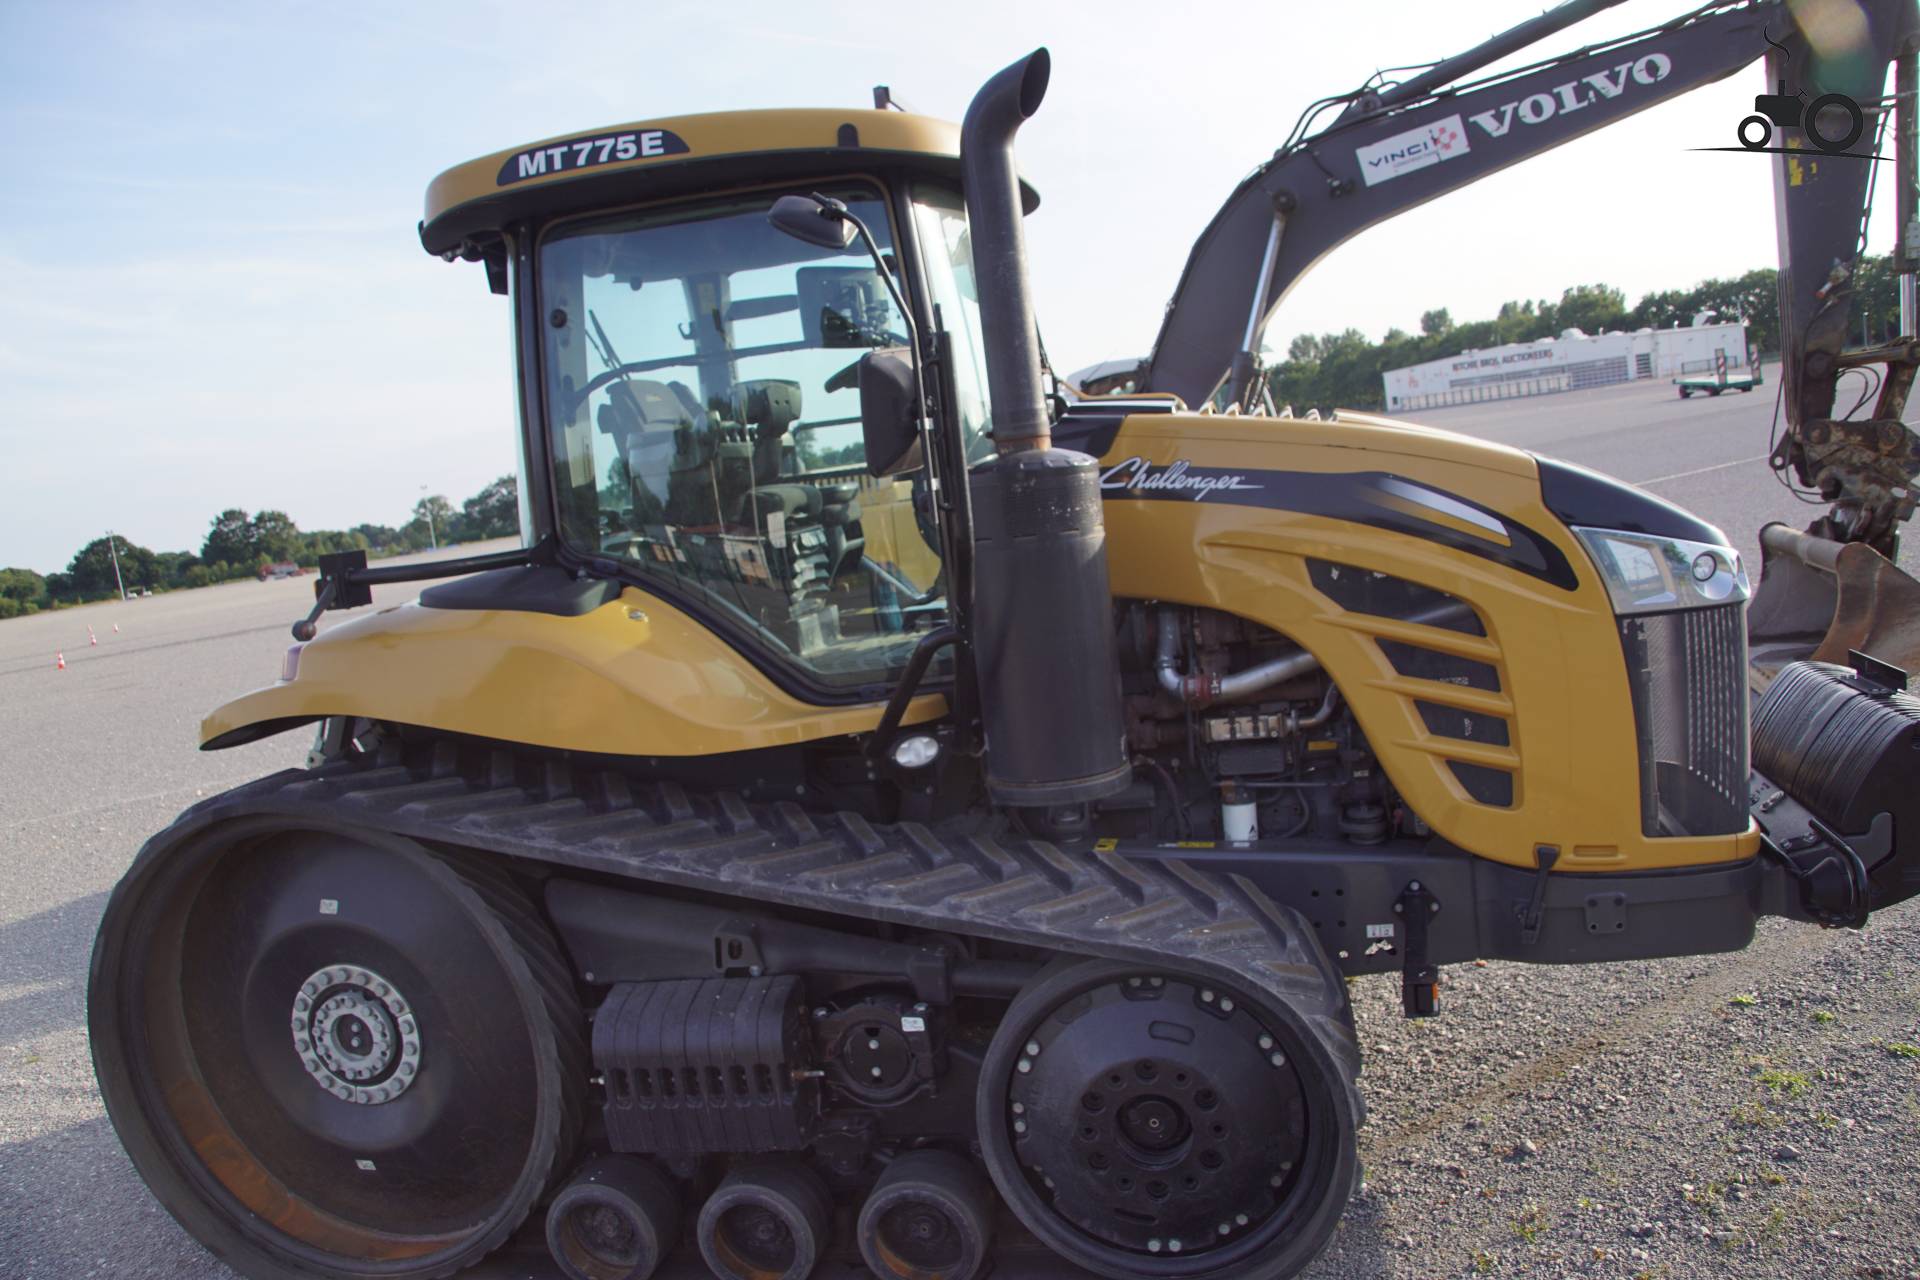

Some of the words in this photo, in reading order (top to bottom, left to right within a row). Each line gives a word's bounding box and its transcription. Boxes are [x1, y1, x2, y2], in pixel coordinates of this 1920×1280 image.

[1469, 53, 1671, 137] VOLVO
[1368, 141, 1428, 167] VINCI
[1100, 456, 1264, 501] Challenger
